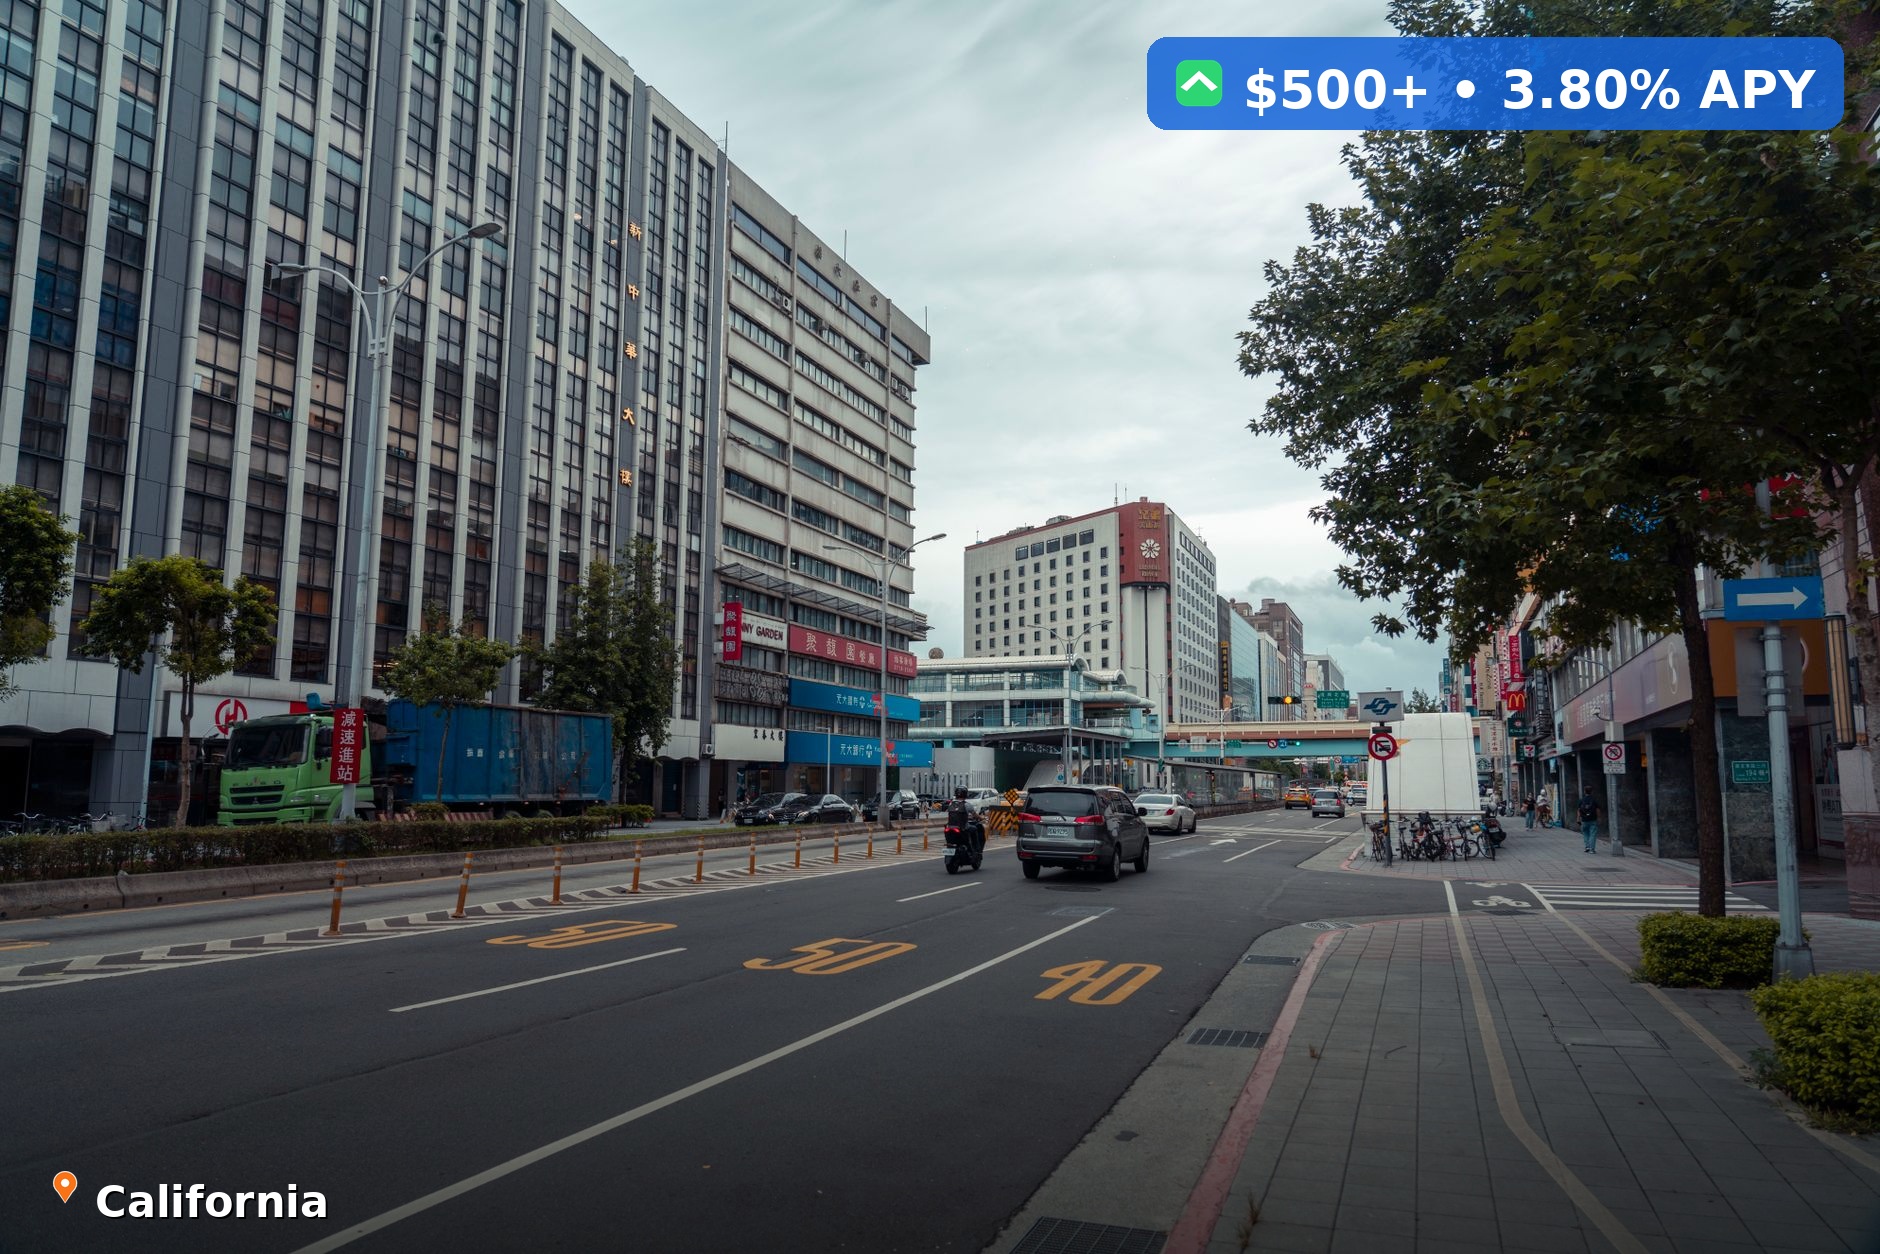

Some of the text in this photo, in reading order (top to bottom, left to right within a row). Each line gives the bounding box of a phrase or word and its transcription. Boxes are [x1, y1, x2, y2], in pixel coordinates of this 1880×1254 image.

[756, 626, 784, 641] GARDEN
[336, 711, 357, 781] 減速進站
[840, 743, 865, 757] 元大銀行
[486, 919, 678, 949] 50
[741, 937, 918, 974] 50
[1033, 959, 1163, 1005] 40
